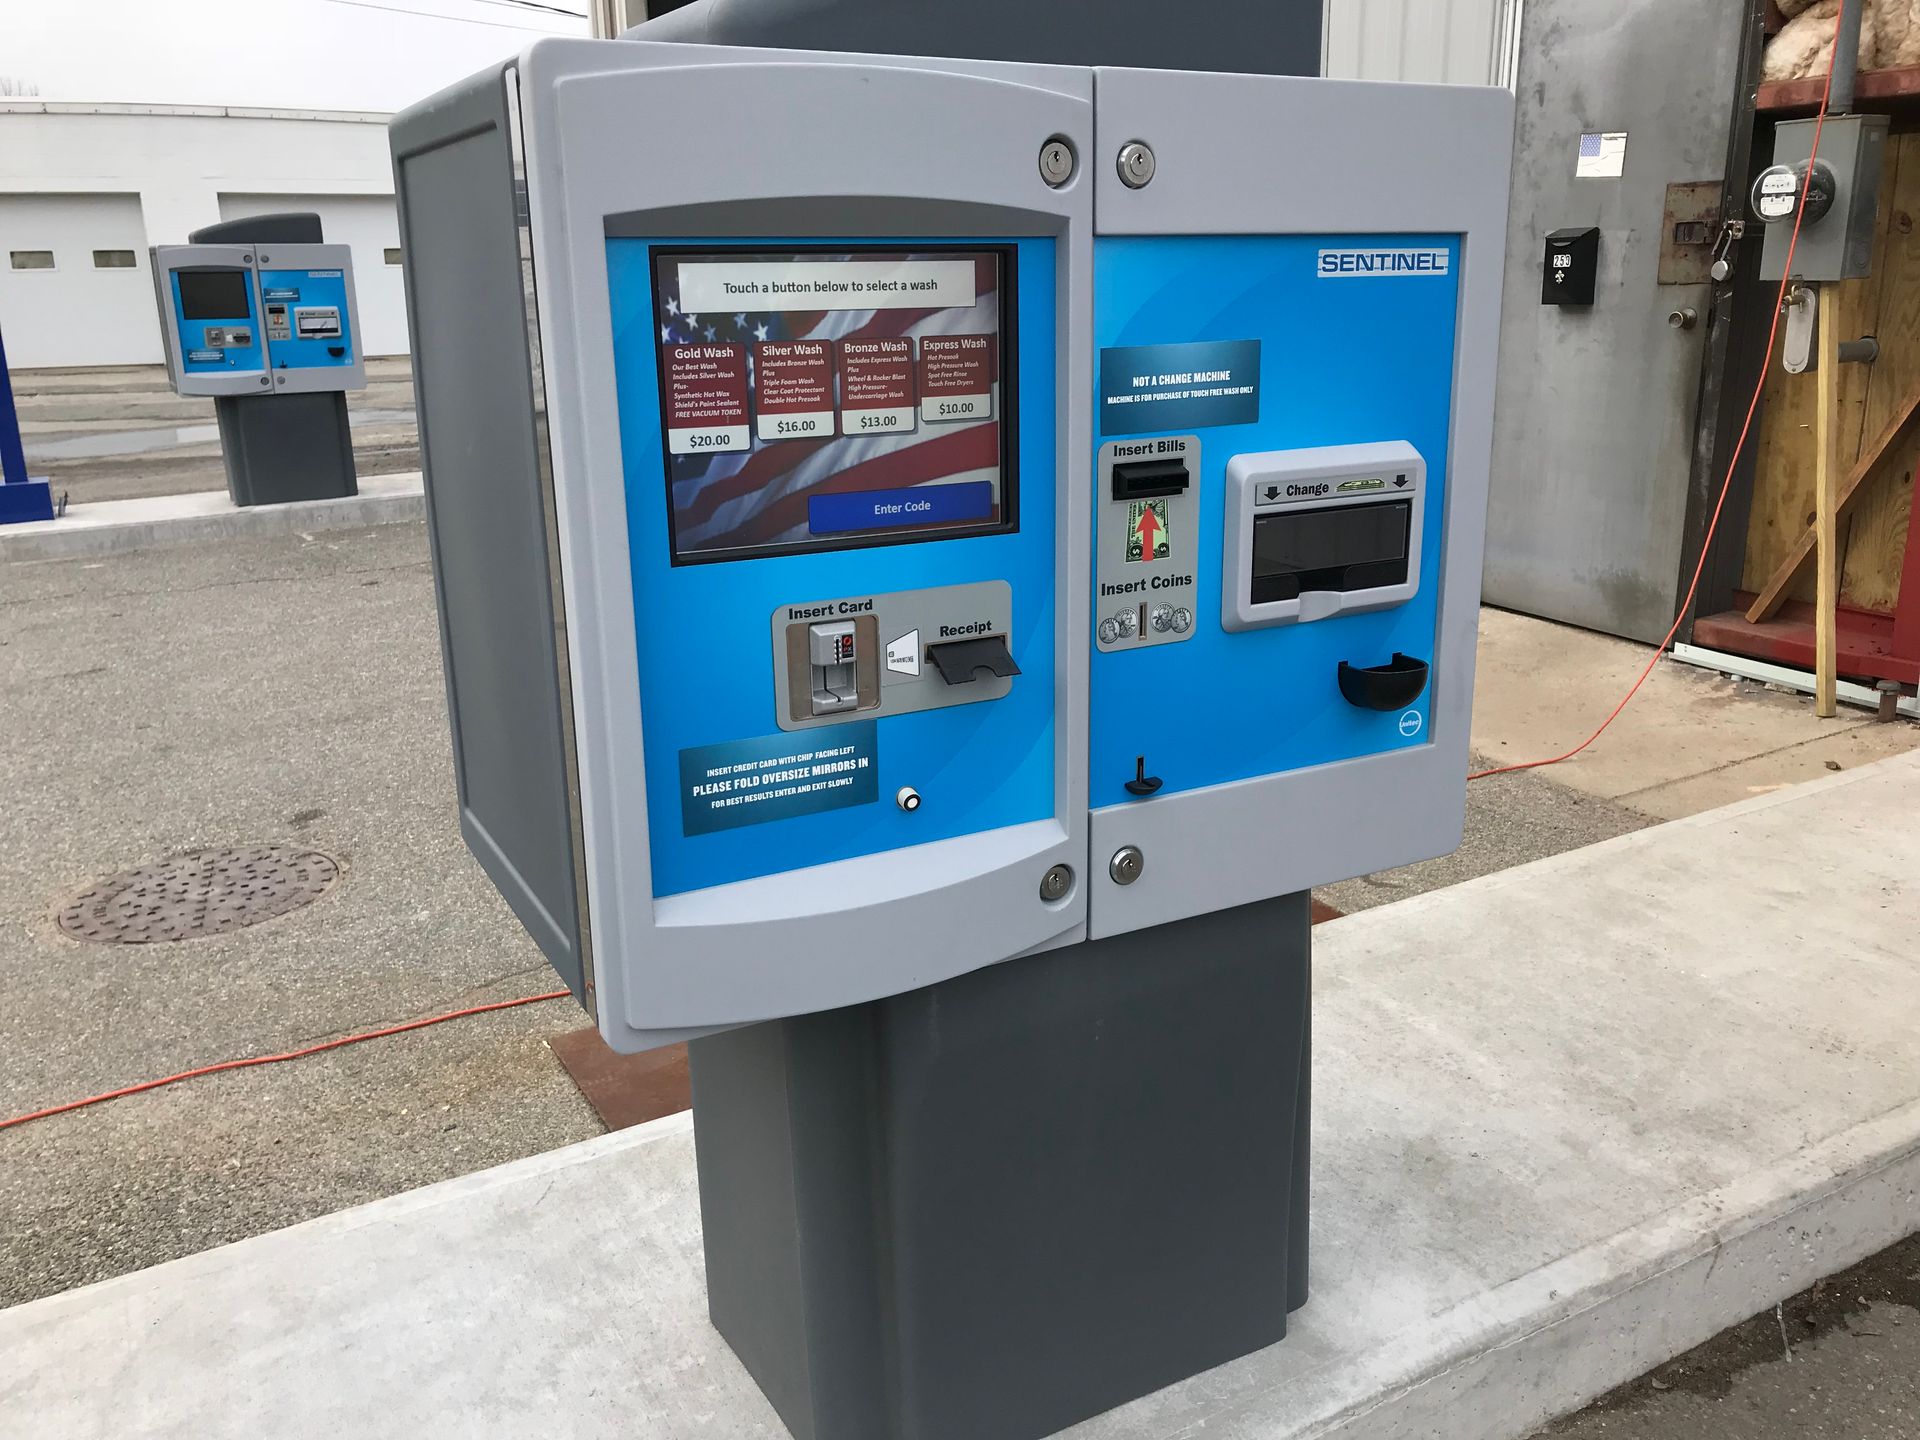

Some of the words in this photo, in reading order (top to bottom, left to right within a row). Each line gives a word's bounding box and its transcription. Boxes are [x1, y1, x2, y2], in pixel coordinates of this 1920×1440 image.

[1321, 253, 1445, 273] SENTINEL
[723, 282, 759, 294] Touch
[762, 284, 769, 293] a
[771, 281, 811, 293] button
[814, 280, 849, 292] below
[851, 281, 863, 292] to
[866, 280, 898, 291] select
[900, 282, 907, 291] a
[910, 279, 938, 291] wash
[762, 345, 792, 356] Silver
[794, 344, 823, 355] Wash
[844, 343, 878, 353] Bronze
[880, 341, 907, 352] Wash
[923, 340, 959, 352] Express
[961, 338, 987, 349] Wash
[675, 348, 701, 359] Gold
[703, 347, 734, 358] Wash
[700, 362, 718, 370] Wash
[927, 363, 940, 371] High
[763, 379, 780, 387] Triple
[927, 372, 940, 380] Spot
[1132, 376, 1151, 387] NOT
[1151, 375, 1158, 386] A
[1158, 373, 1192, 385] CHANGE
[1193, 370, 1231, 383] MACHINE
[848, 384, 861, 392] High
[1107, 395, 1134, 404] MACHINE
[1141, 394, 1152, 402] FOR
[1152, 392, 1182, 401] PURCHASE
[1190, 389, 1209, 398] TOUCH
[1209, 388, 1223, 396] FREE
[1223, 387, 1239, 395] WASH
[1239, 386, 1254, 394] ONLY
[674, 392, 702, 400] Synthetic
[674, 401, 698, 409] Shield's
[939, 403, 974, 416] $10.00
[777, 420, 816, 434] $16.00
[860, 415, 897, 429] $13.00
[690, 434, 730, 449] $20.00
[1113, 443, 1153, 457] Insert
[1157, 439, 1186, 453] Bills
[1286, 482, 1329, 497] Change
[874, 504, 902, 515] Enter
[904, 500, 931, 512] Code
[1101, 578, 1147, 596] Insert
[1150, 573, 1193, 590] Coins
[788, 604, 834, 621] Insert
[838, 599, 873, 615] Card
[939, 620, 993, 637] Receipt
[706, 766, 732, 778] INSERT
[733, 761, 758, 773] CREDIT
[759, 758, 778, 769] CARD
[778, 755, 797, 766] WITH
[797, 753, 813, 762] CHIP
[815, 749, 839, 760] FACING
[839, 745, 855, 755] LEFT
[692, 780, 732, 797] PLEASE
[733, 775, 760, 790] FOLD
[762, 769, 811, 785] OVERSIZE
[811, 759, 856, 776] MIRRORS
[858, 757, 869, 769] IN
[711, 800, 726, 809] FOR
[726, 797, 744, 806] BEST
[744, 791, 774, 803] RESULTS
[774, 787, 797, 798] ENTER
[797, 785, 811, 794] AND
[812, 781, 827, 791] EXIT
[827, 777, 854, 789] SLOWLY
